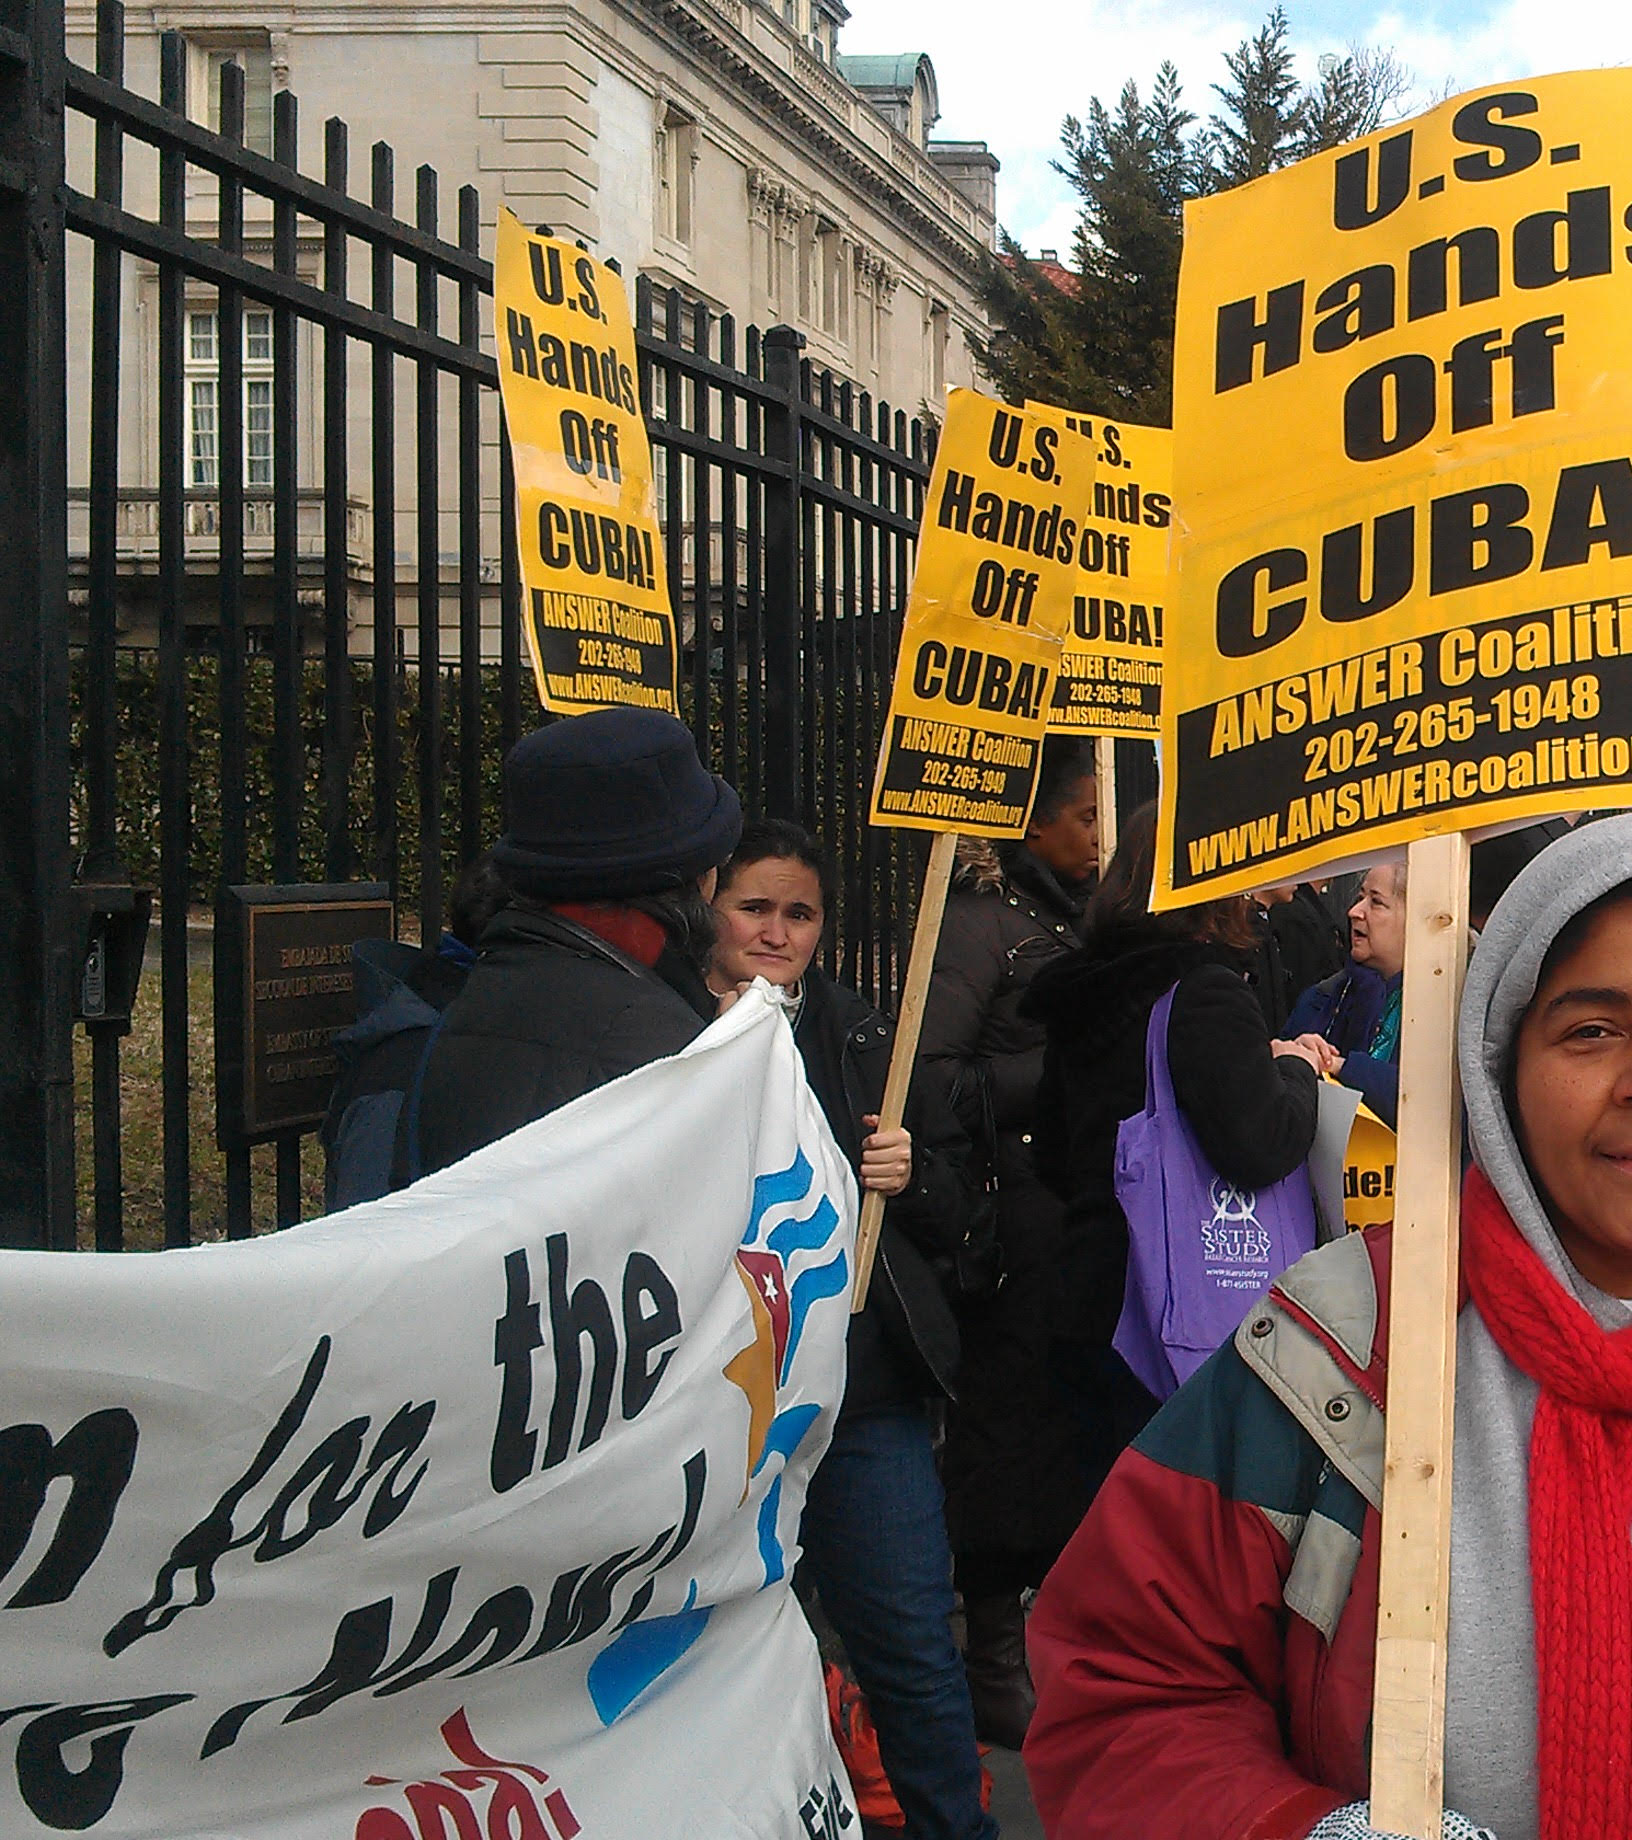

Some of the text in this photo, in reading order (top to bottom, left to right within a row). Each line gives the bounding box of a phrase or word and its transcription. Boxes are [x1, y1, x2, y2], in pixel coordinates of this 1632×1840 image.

[1334, 91, 1580, 231] U.S.
[528, 240, 608, 326] U.S.
[506, 307, 637, 416] Hands
[1343, 314, 1565, 462] Off
[559, 409, 621, 485] Off
[988, 409, 1062, 486] U.S.
[539, 501, 656, 590] CUBA!
[937, 469, 1077, 565] Hands
[1078, 528, 1130, 577] Off
[542, 591, 664, 646] ANSWER Coalition
[971, 559, 1040, 627] Off
[1066, 596, 1164, 648] UBA!
[913, 640, 1049, 720] CUBA!
[1209, 641, 1424, 759] ANSWER
[900, 719, 1033, 769] ANSWER Coalition
[1303, 674, 1601, 783] 202-265-1948
[882, 789, 1024, 827] www.ANSWERcoalition.org
[921, 760, 1006, 794] 202-265-1948
[1201, 1225, 1271, 1243] SISTER
[1204, 1240, 1272, 1256] STUDY
[103, 1334, 436, 1658] for
[491, 1231, 682, 1494] the
